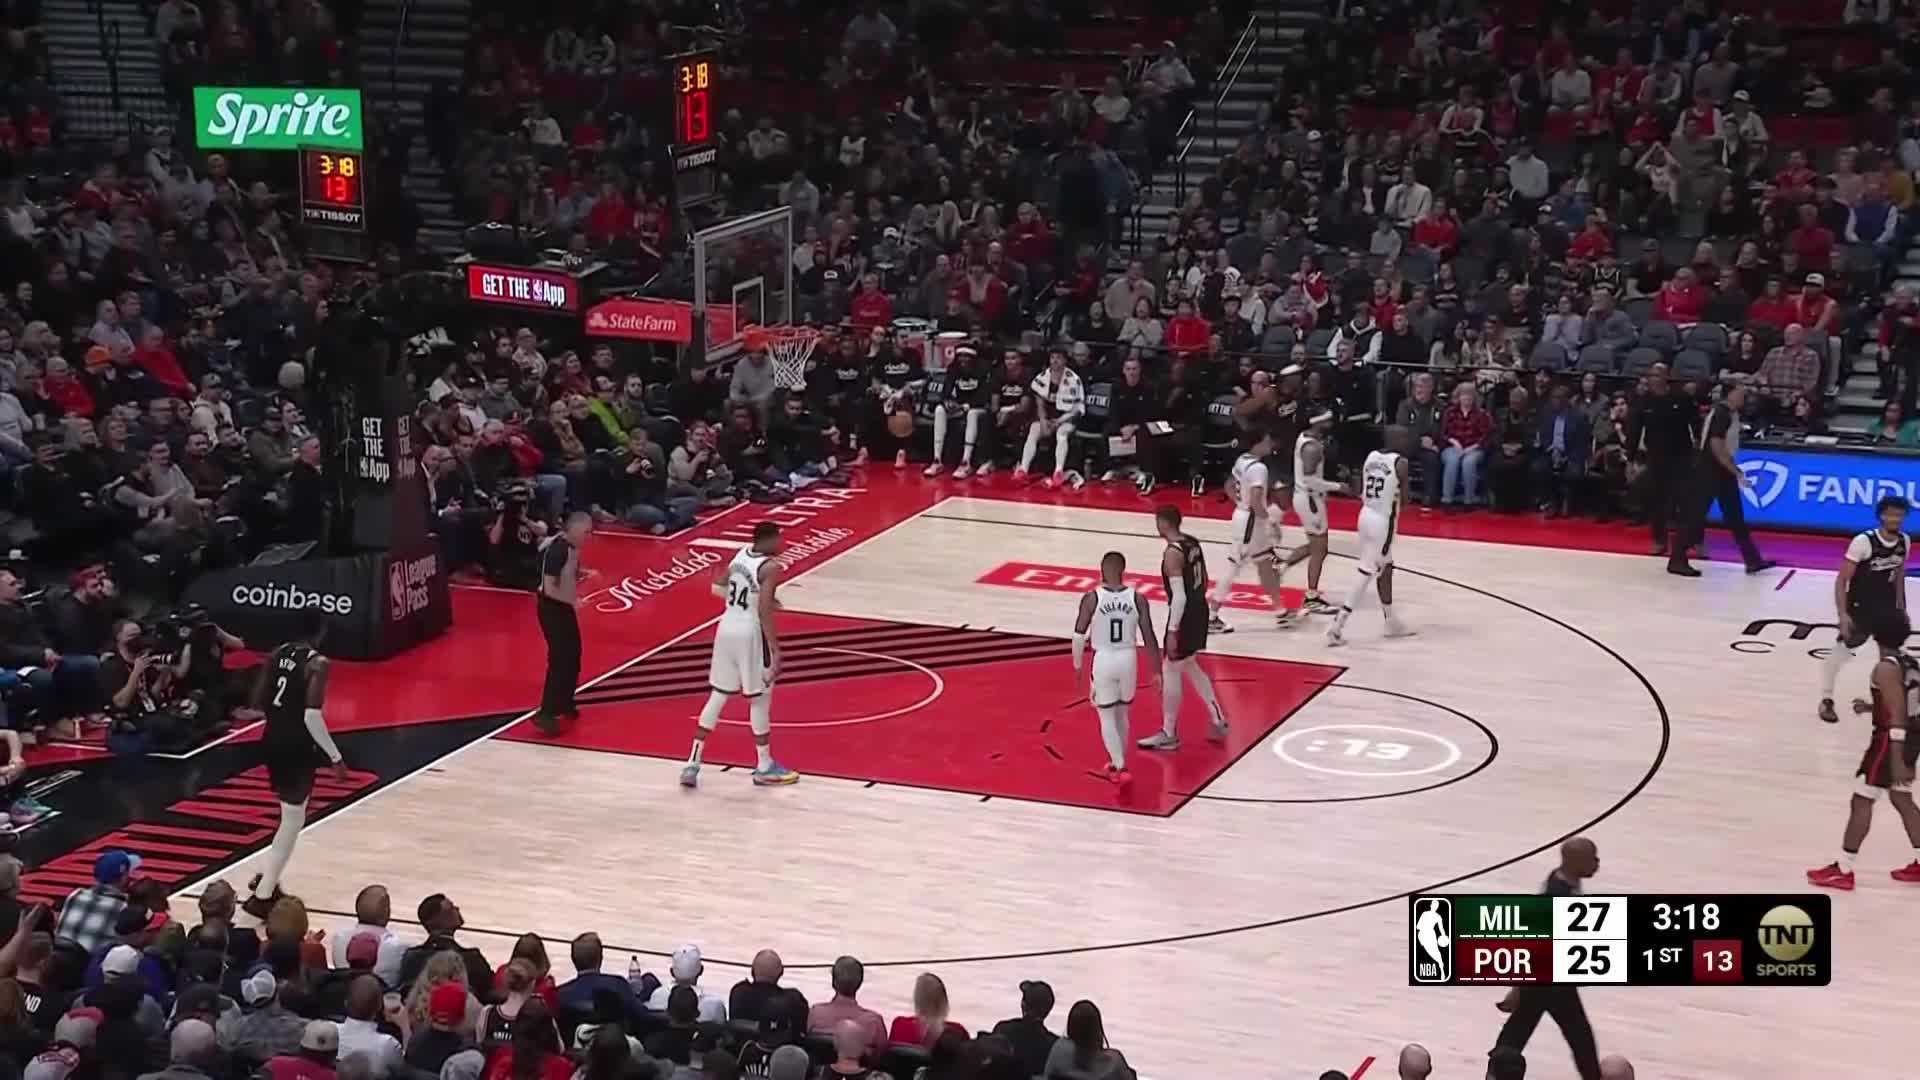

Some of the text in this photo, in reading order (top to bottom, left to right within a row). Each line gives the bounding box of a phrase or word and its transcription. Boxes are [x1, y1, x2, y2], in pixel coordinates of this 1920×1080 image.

[681, 62, 709, 92] 3:18
[208, 92, 350, 145] Sprite
[686, 91, 708, 141] 13
[319, 155, 355, 177] 3:18
[326, 176, 347, 202] 13
[320, 209, 361, 223] TISSOT
[482, 273, 565, 307] GET THE App
[362, 416, 382, 437] GET
[363, 437, 385, 457] THE
[369, 457, 390, 483] App
[1365, 475, 1385, 499] 22
[404, 554, 437, 586] League
[596, 548, 722, 613] Michelob
[232, 582, 353, 614] coinbase
[406, 586, 429, 613] Pass
[728, 580, 749, 611] 34
[1110, 618, 1123, 643] 0
[272, 675, 288, 708] 2
